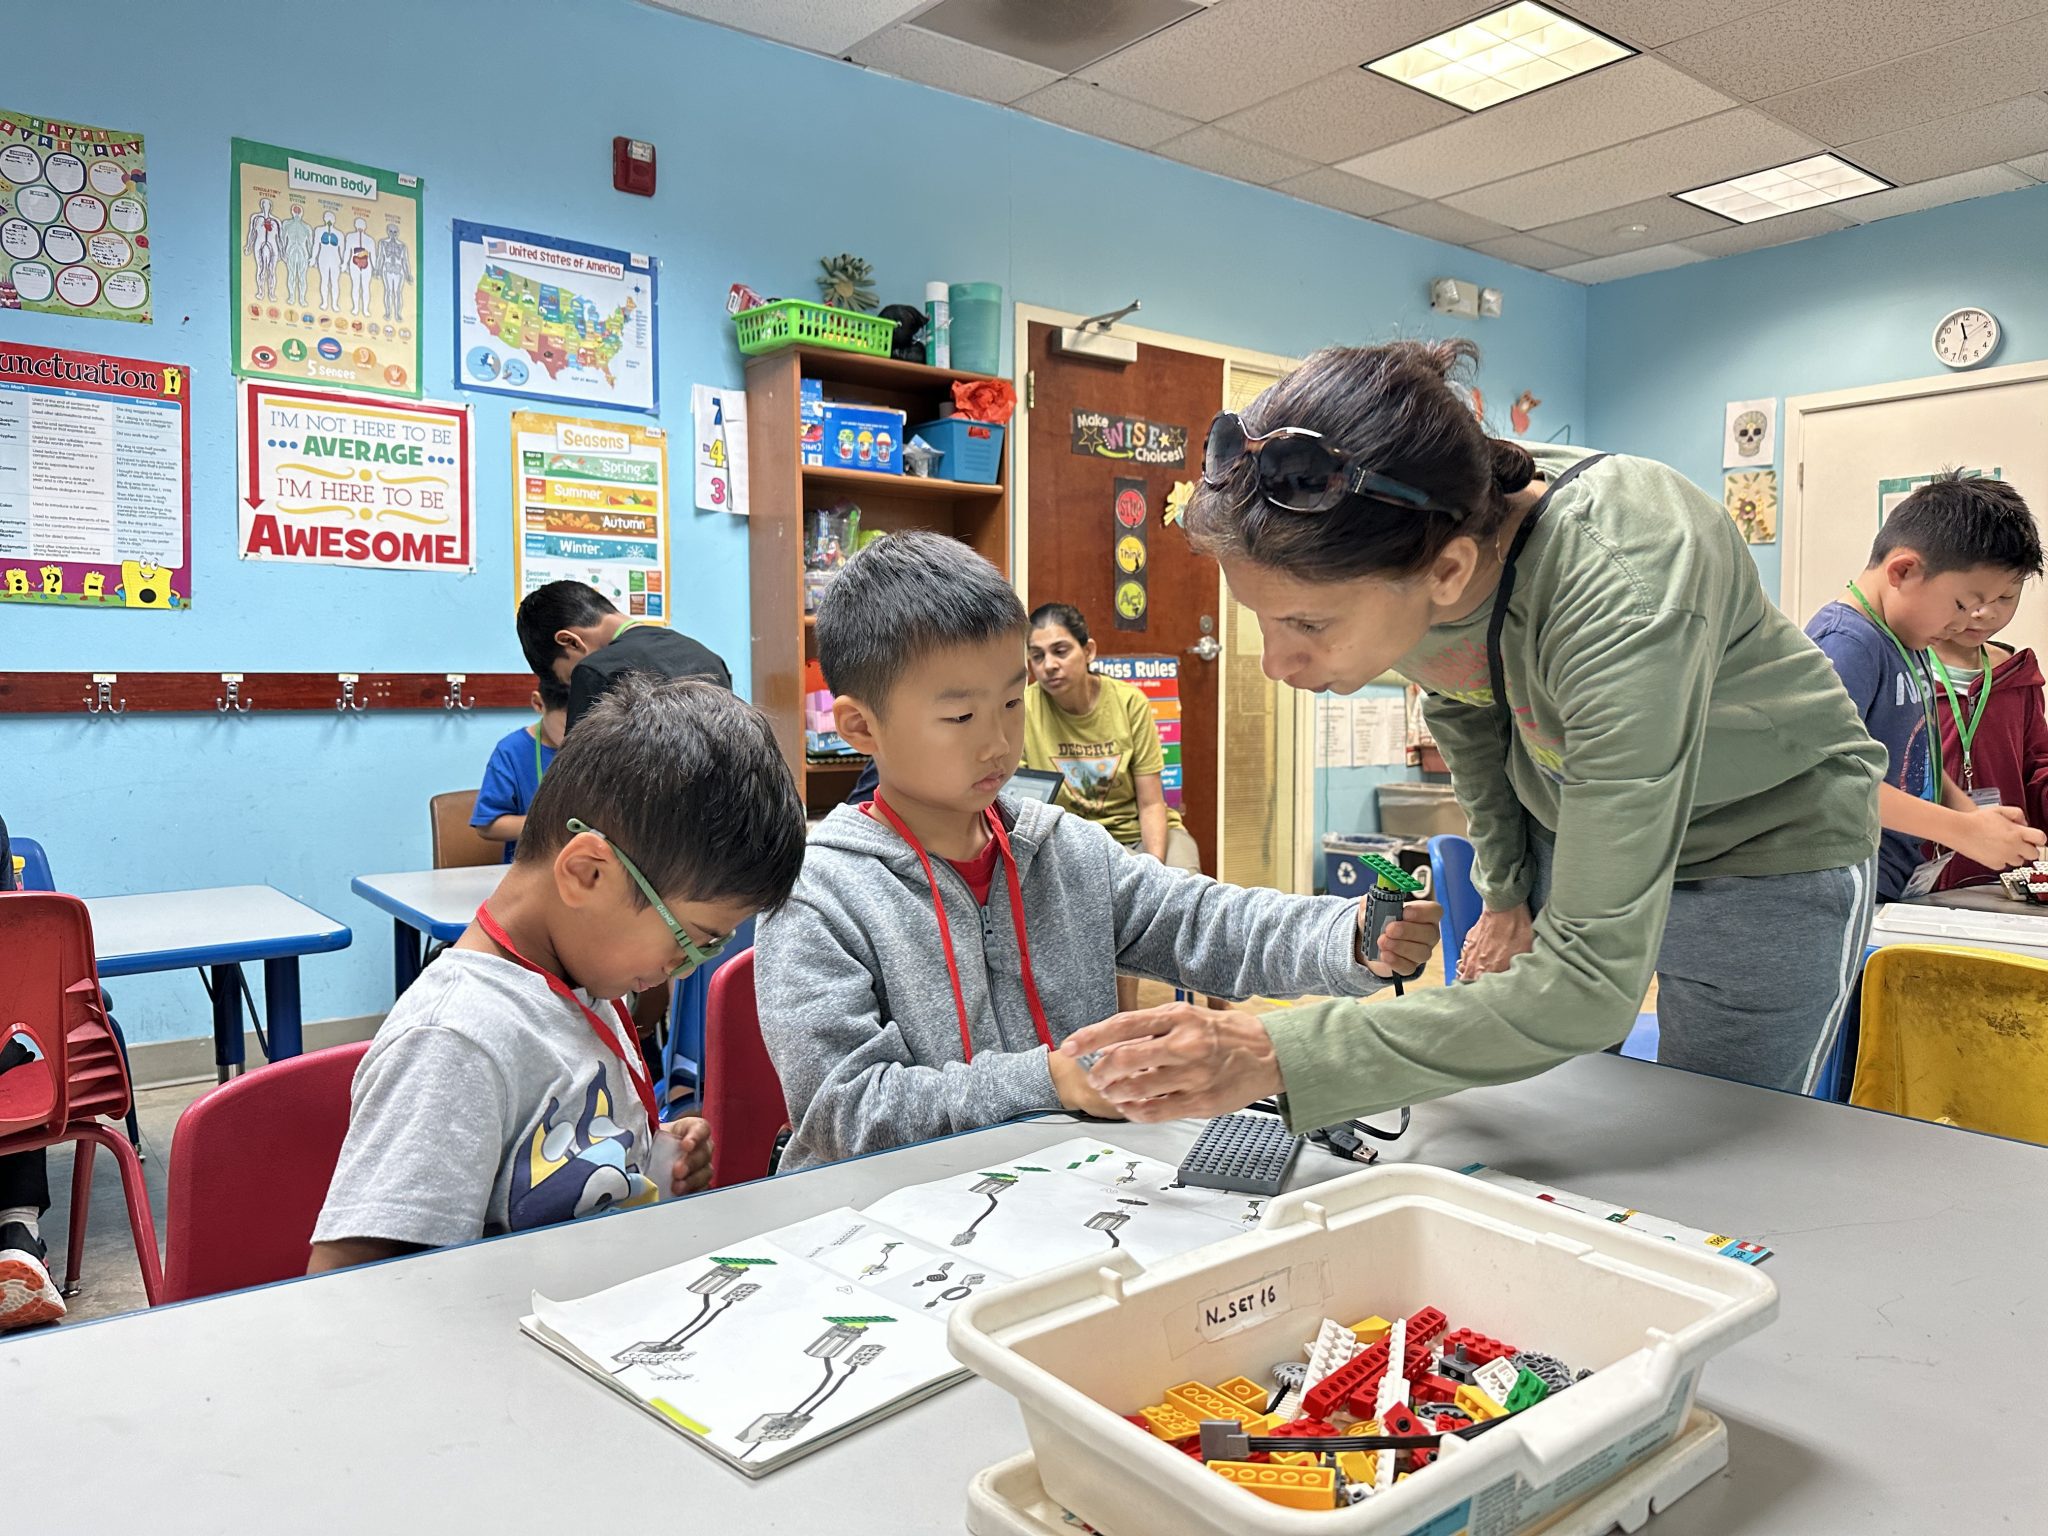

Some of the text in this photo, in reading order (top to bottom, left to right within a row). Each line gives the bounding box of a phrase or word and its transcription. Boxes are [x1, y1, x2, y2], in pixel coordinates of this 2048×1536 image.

[3, 123, 138, 153] BIRTHDAY
[33, 120, 105, 139] HAPPY
[294, 167, 372, 195] Human Body
[509, 244, 621, 276] United States of America
[1963, 312, 1970, 321] 12
[0, 352, 157, 390] unctuation
[307, 360, 356, 379] 5 senses
[712, 397, 722, 425] 7
[270, 411, 451, 444] I'M NOT HERE TO BE
[1077, 414, 1109, 428] Make
[563, 430, 624, 449] Seasons
[1103, 422, 1160, 449] WISE
[303, 435, 423, 466] AVERAGE
[1135, 447, 1184, 463] Choices!
[602, 461, 641, 477] Spring
[277, 478, 444, 509] I'M HERE TO BE
[554, 484, 602, 500] Summer
[711, 477, 725, 504] 3
[602, 515, 646, 530] Autumn
[247, 513, 457, 563] AWESOME
[560, 540, 600, 555] Winter
[1120, 548, 1142, 560] Think
[47, 574, 60, 593] ?
[1120, 592, 1143, 607] Act
[1089, 661, 1177, 678] Class Rules
[1058, 742, 1114, 756] DESERT
[1260, 1285, 1276, 1307] 16
